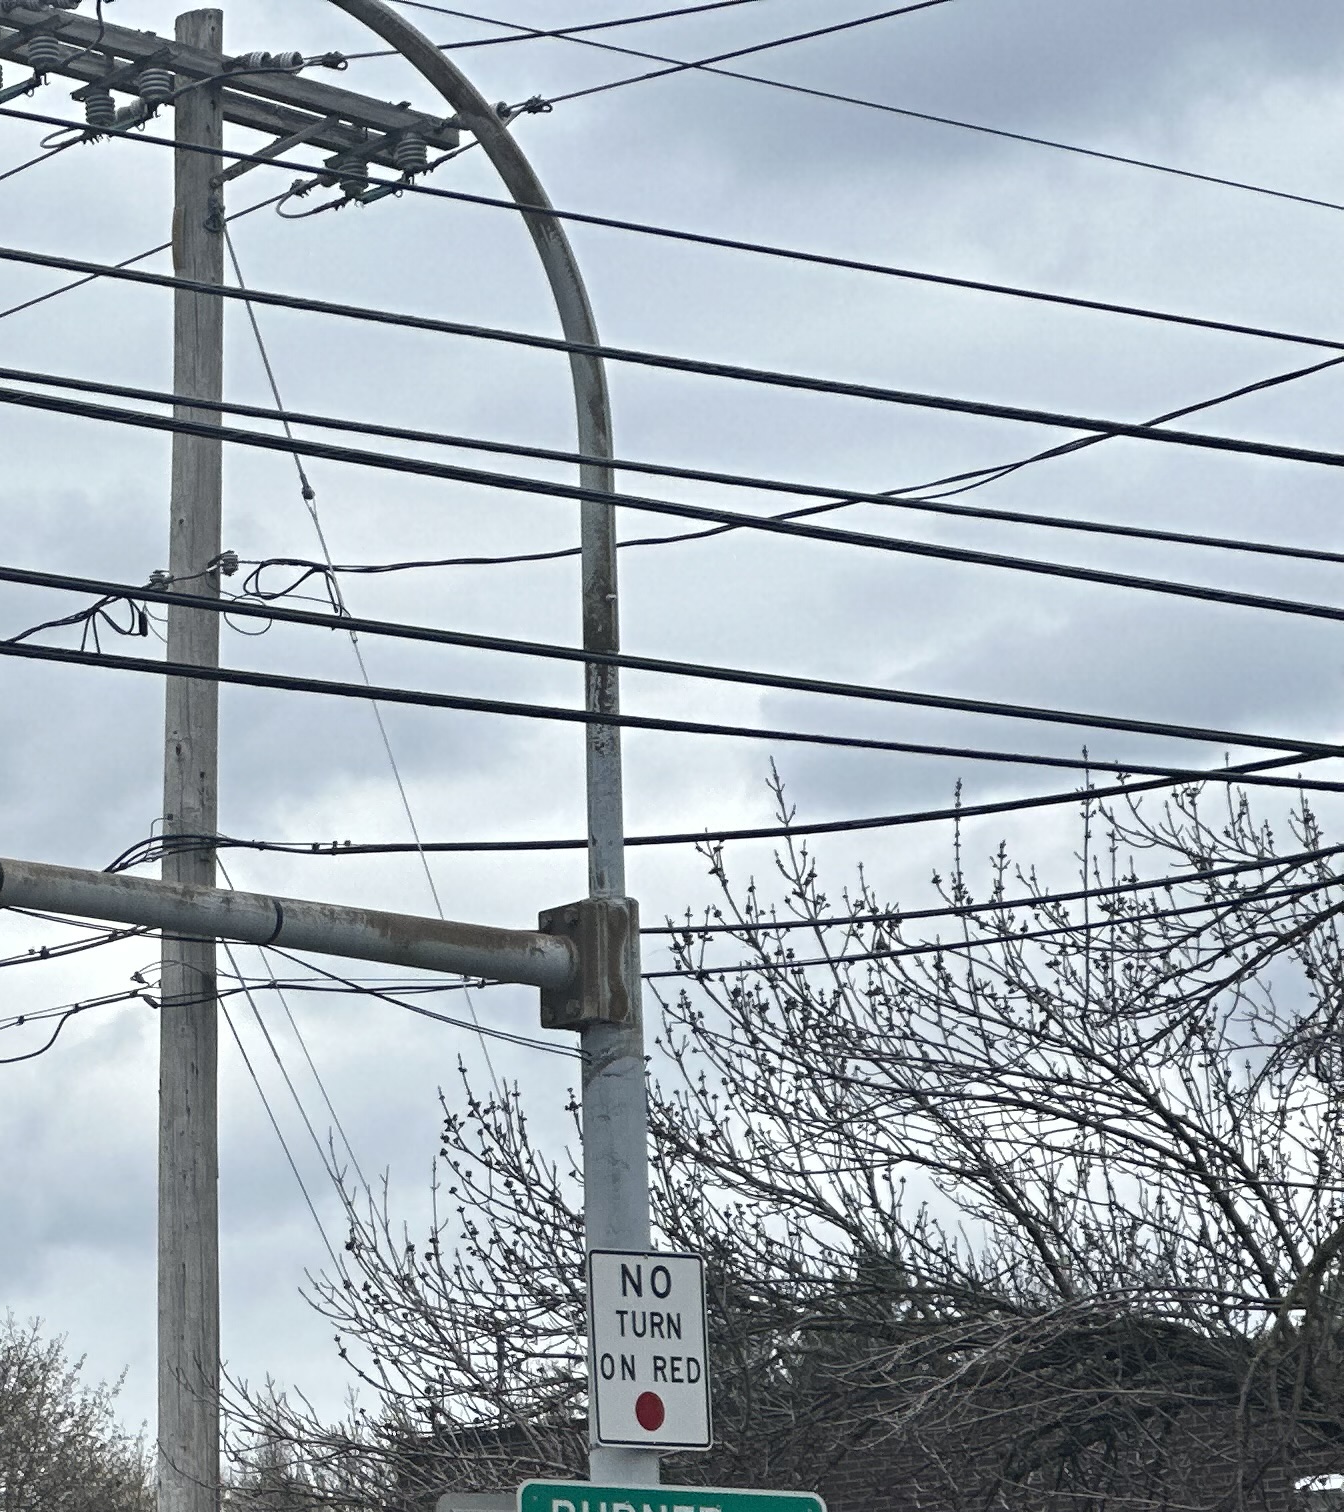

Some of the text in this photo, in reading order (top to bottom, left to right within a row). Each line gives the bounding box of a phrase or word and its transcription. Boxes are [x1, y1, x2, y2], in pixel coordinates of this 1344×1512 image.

[620, 1264, 672, 1298] NO
[615, 1310, 682, 1340] TURN
[600, 1353, 701, 1384] ON RED
